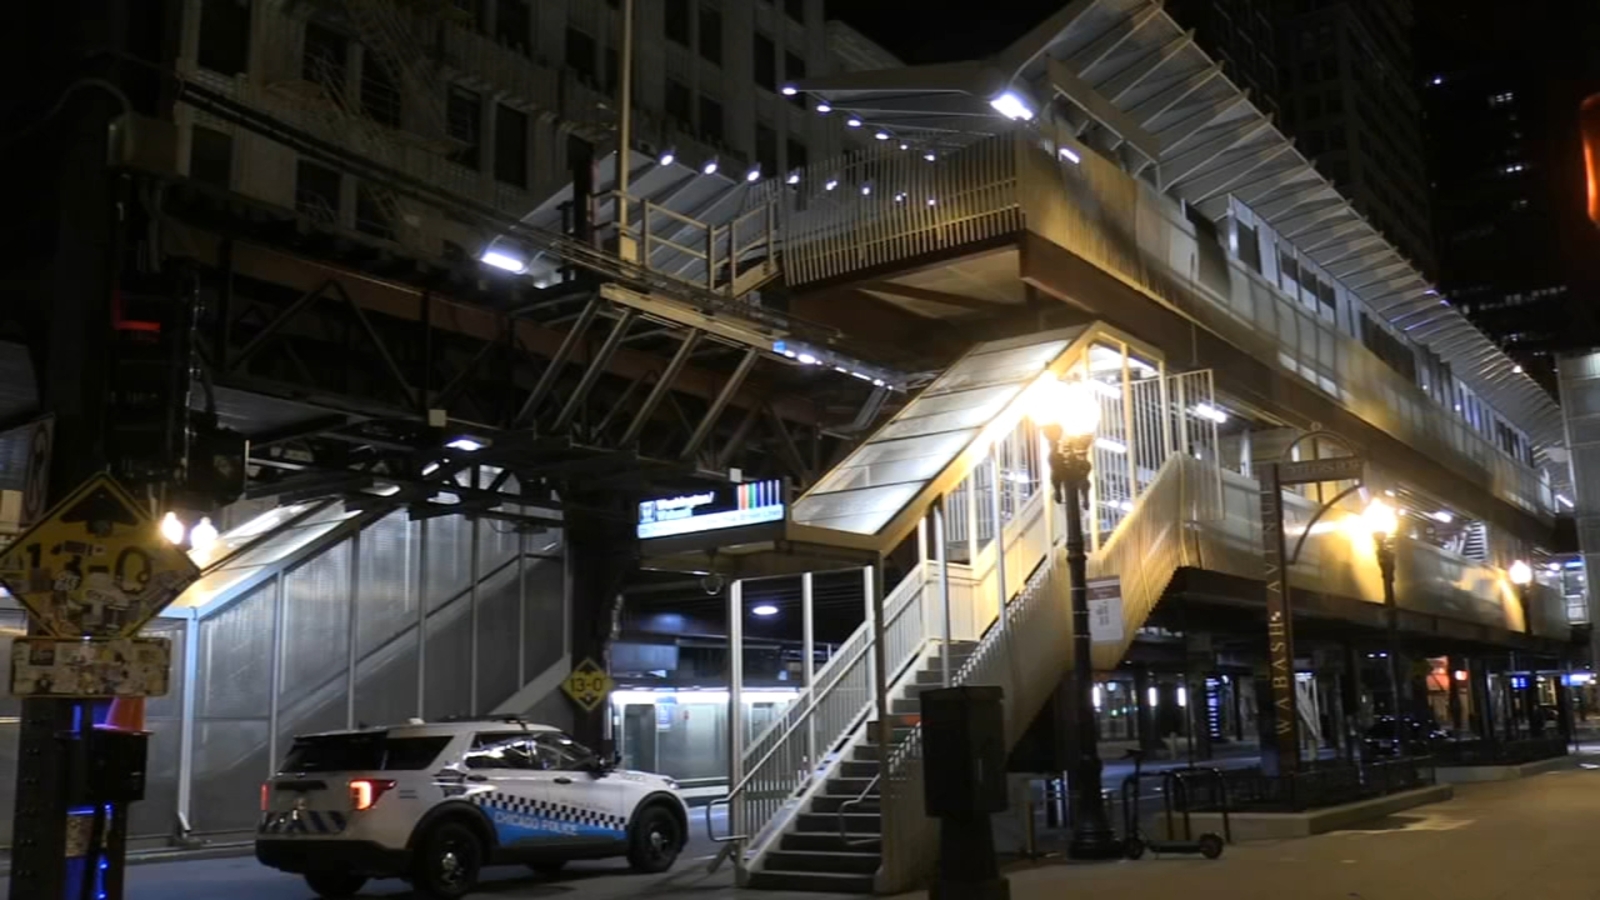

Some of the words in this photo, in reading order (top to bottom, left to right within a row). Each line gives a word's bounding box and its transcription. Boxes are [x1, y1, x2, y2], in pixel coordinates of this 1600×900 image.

[571, 678, 603, 692] 13-0
[1269, 621, 1292, 735] WABASH
[494, 810, 539, 830] CHICAGO
[541, 819, 578, 834] POLICE
